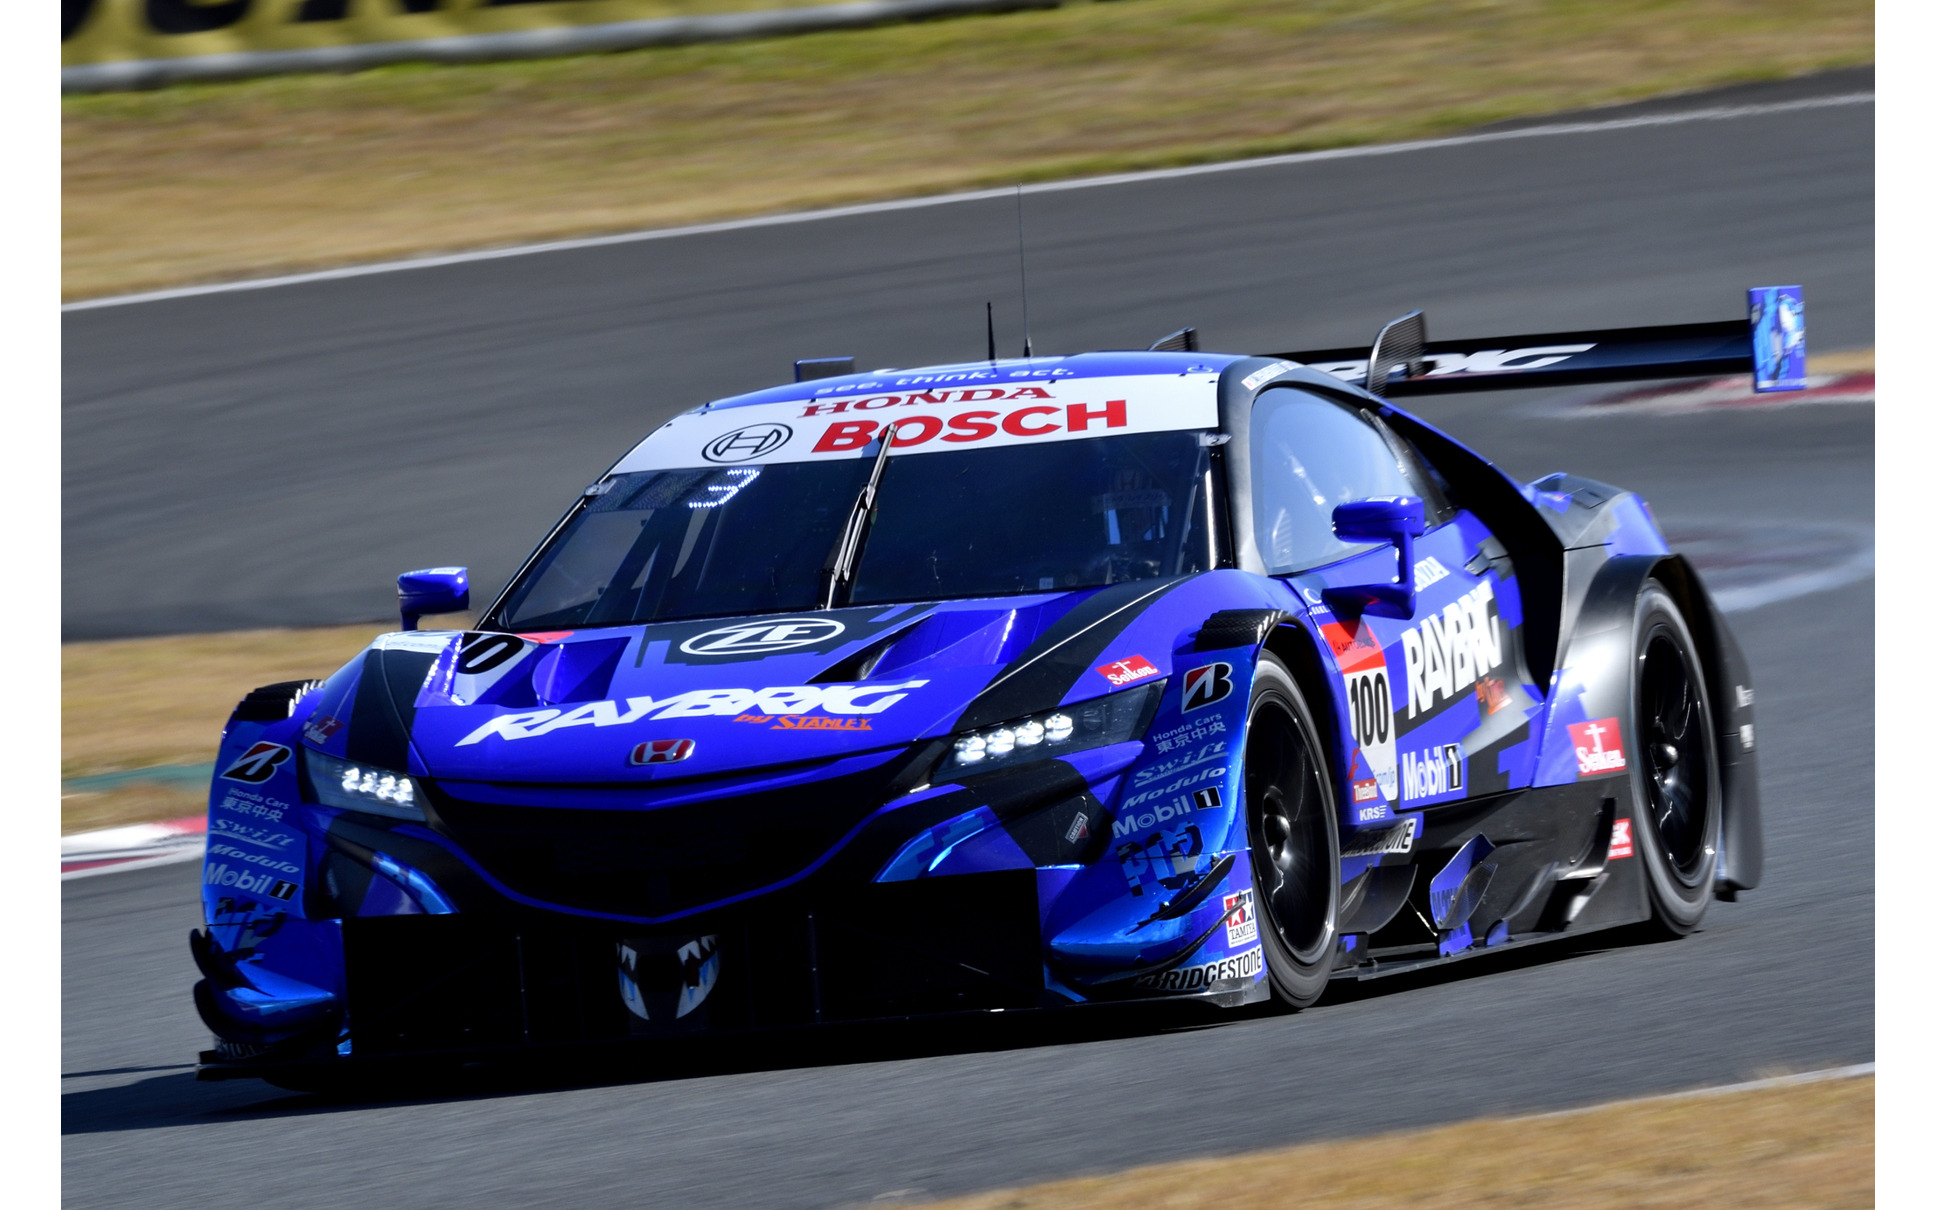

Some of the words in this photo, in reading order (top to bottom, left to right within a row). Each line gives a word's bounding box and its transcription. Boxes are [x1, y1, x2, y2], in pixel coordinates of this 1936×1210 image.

[896, 370, 998, 387] think.
[1009, 367, 1075, 379] act.
[796, 386, 1057, 419] HONDA
[811, 398, 1127, 453] BOSCH
[690, 621, 840, 652] ZF
[1401, 580, 1503, 719] RAYBRIG
[454, 679, 931, 747] RAYBRIG
[769, 713, 873, 731] STANLEY
[1351, 672, 1389, 748] 100
[1152, 723, 1193, 743] Honda
[1194, 712, 1223, 727] Cars
[1156, 721, 1227, 754] 東京中央
[1121, 767, 1227, 810] Modulo
[1402, 746, 1447, 801] Mobil
[220, 796, 284, 823] 東京中央
[228, 787, 264, 802] Honda
[265, 797, 290, 810] Cars
[1111, 794, 1191, 839] Mobil
[208, 844, 300, 873] Modulo
[205, 862, 274, 895] Mobil
